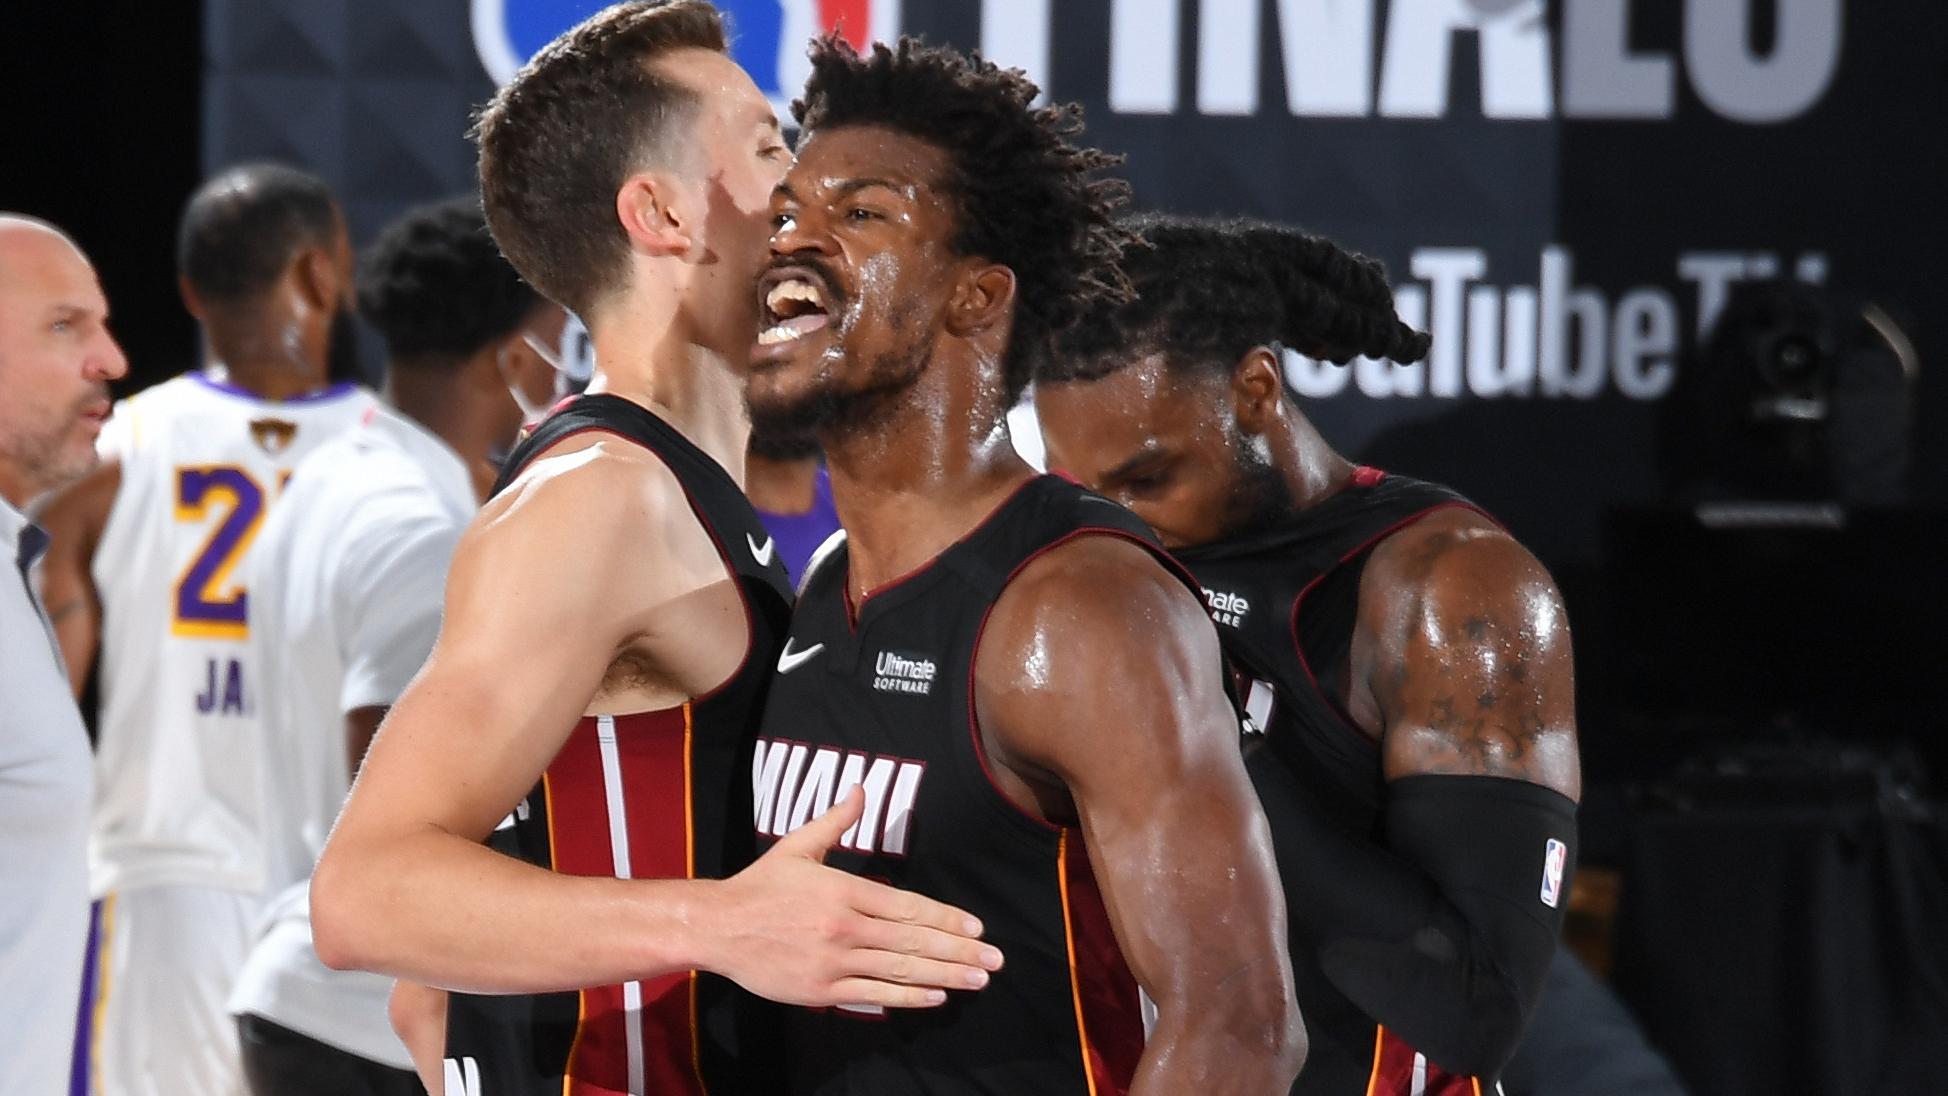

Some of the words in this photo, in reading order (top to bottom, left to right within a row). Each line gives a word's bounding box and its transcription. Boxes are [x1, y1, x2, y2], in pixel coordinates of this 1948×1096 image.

[875, 651, 936, 680] Ultimate
[873, 676, 931, 695] SOFTWARE
[751, 736, 925, 857] MIAMI
